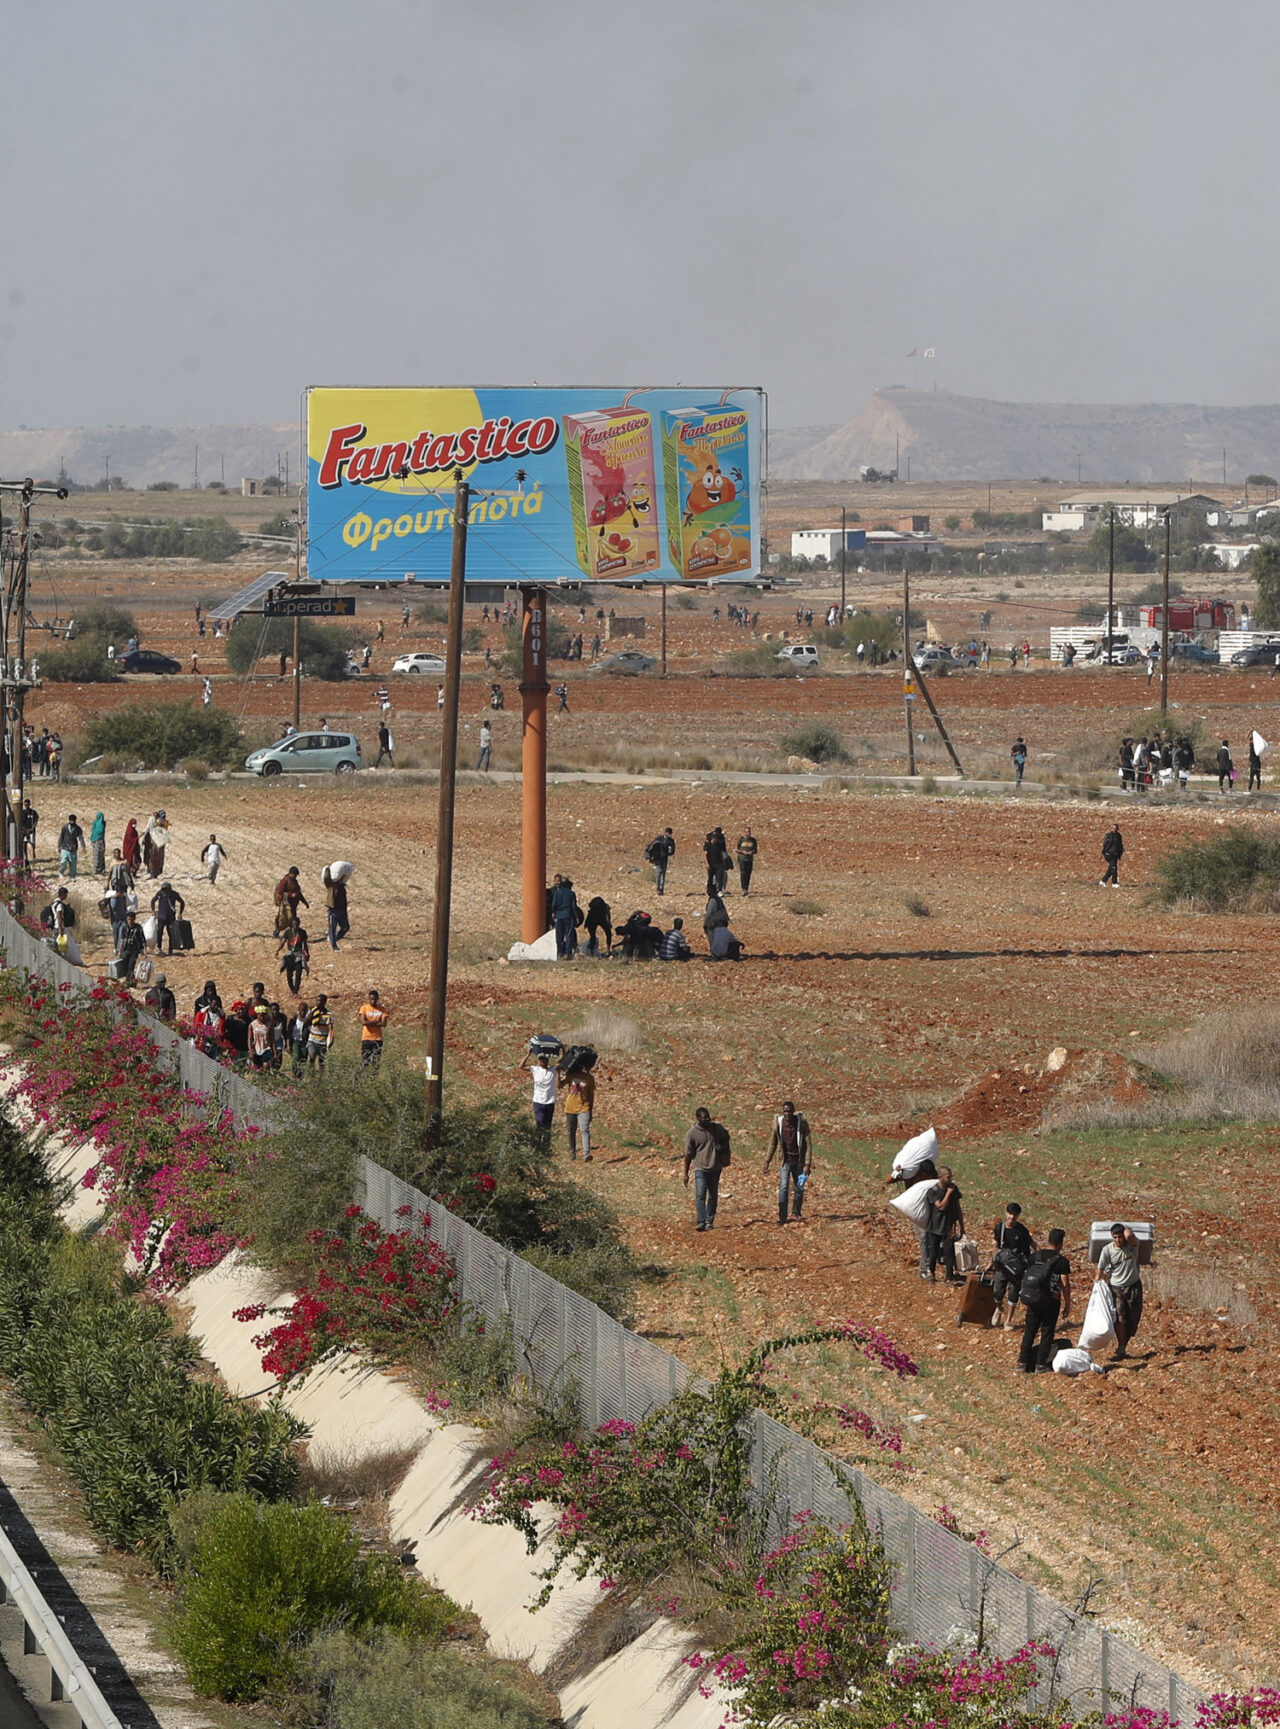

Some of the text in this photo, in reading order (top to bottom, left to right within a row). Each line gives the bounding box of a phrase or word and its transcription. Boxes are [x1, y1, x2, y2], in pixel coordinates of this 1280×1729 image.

[583, 417, 649, 447] Fantastico
[679, 414, 746, 441] Fantastico
[318, 416, 559, 489] Fantastico
